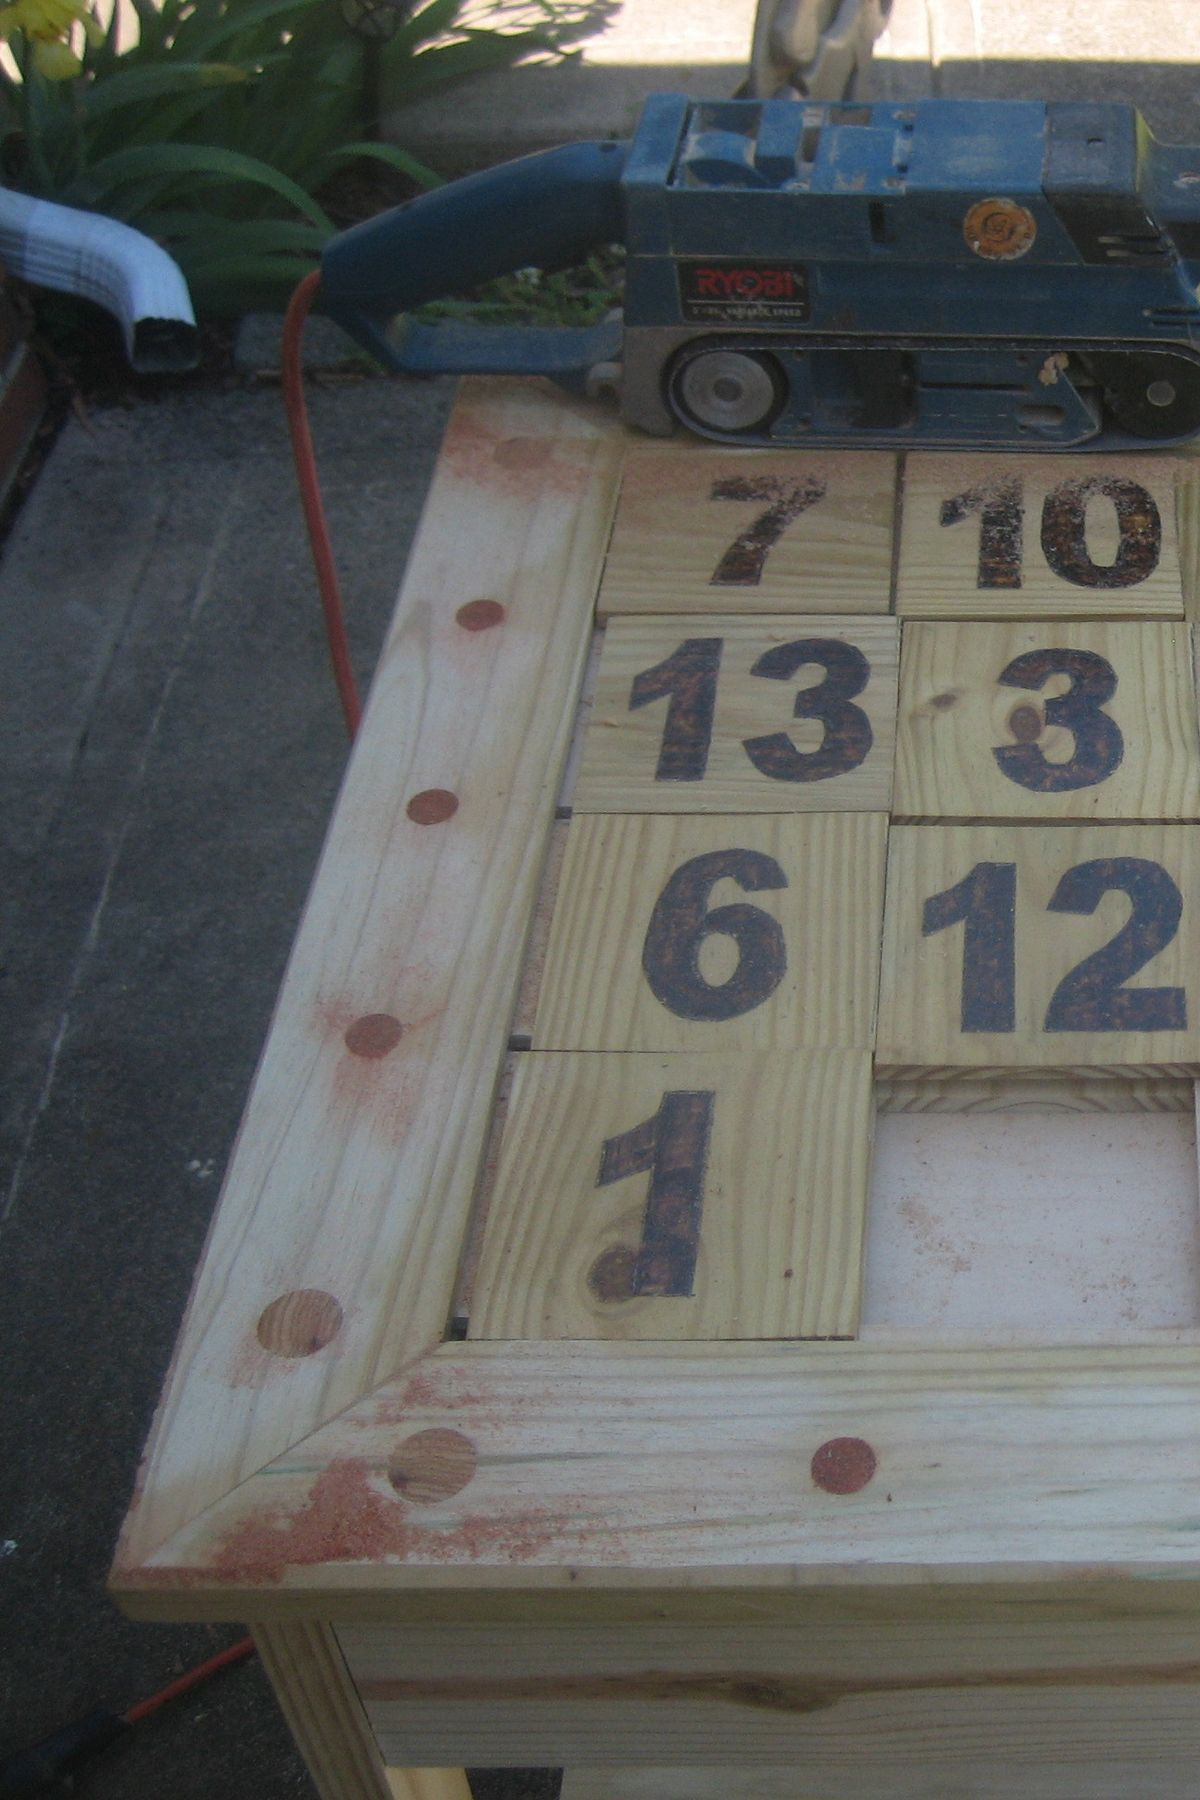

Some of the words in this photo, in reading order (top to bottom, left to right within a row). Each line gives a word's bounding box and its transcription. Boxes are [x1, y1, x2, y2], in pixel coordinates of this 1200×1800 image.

[696, 269, 795, 297] RYOBI
[709, 475, 827, 586] 7
[939, 474, 1162, 589] 10
[629, 637, 873, 783] 13
[992, 648, 1124, 793] 3
[641, 848, 788, 1022] 6
[922, 856, 1189, 1034] 12
[595, 1090, 715, 1298] 1
